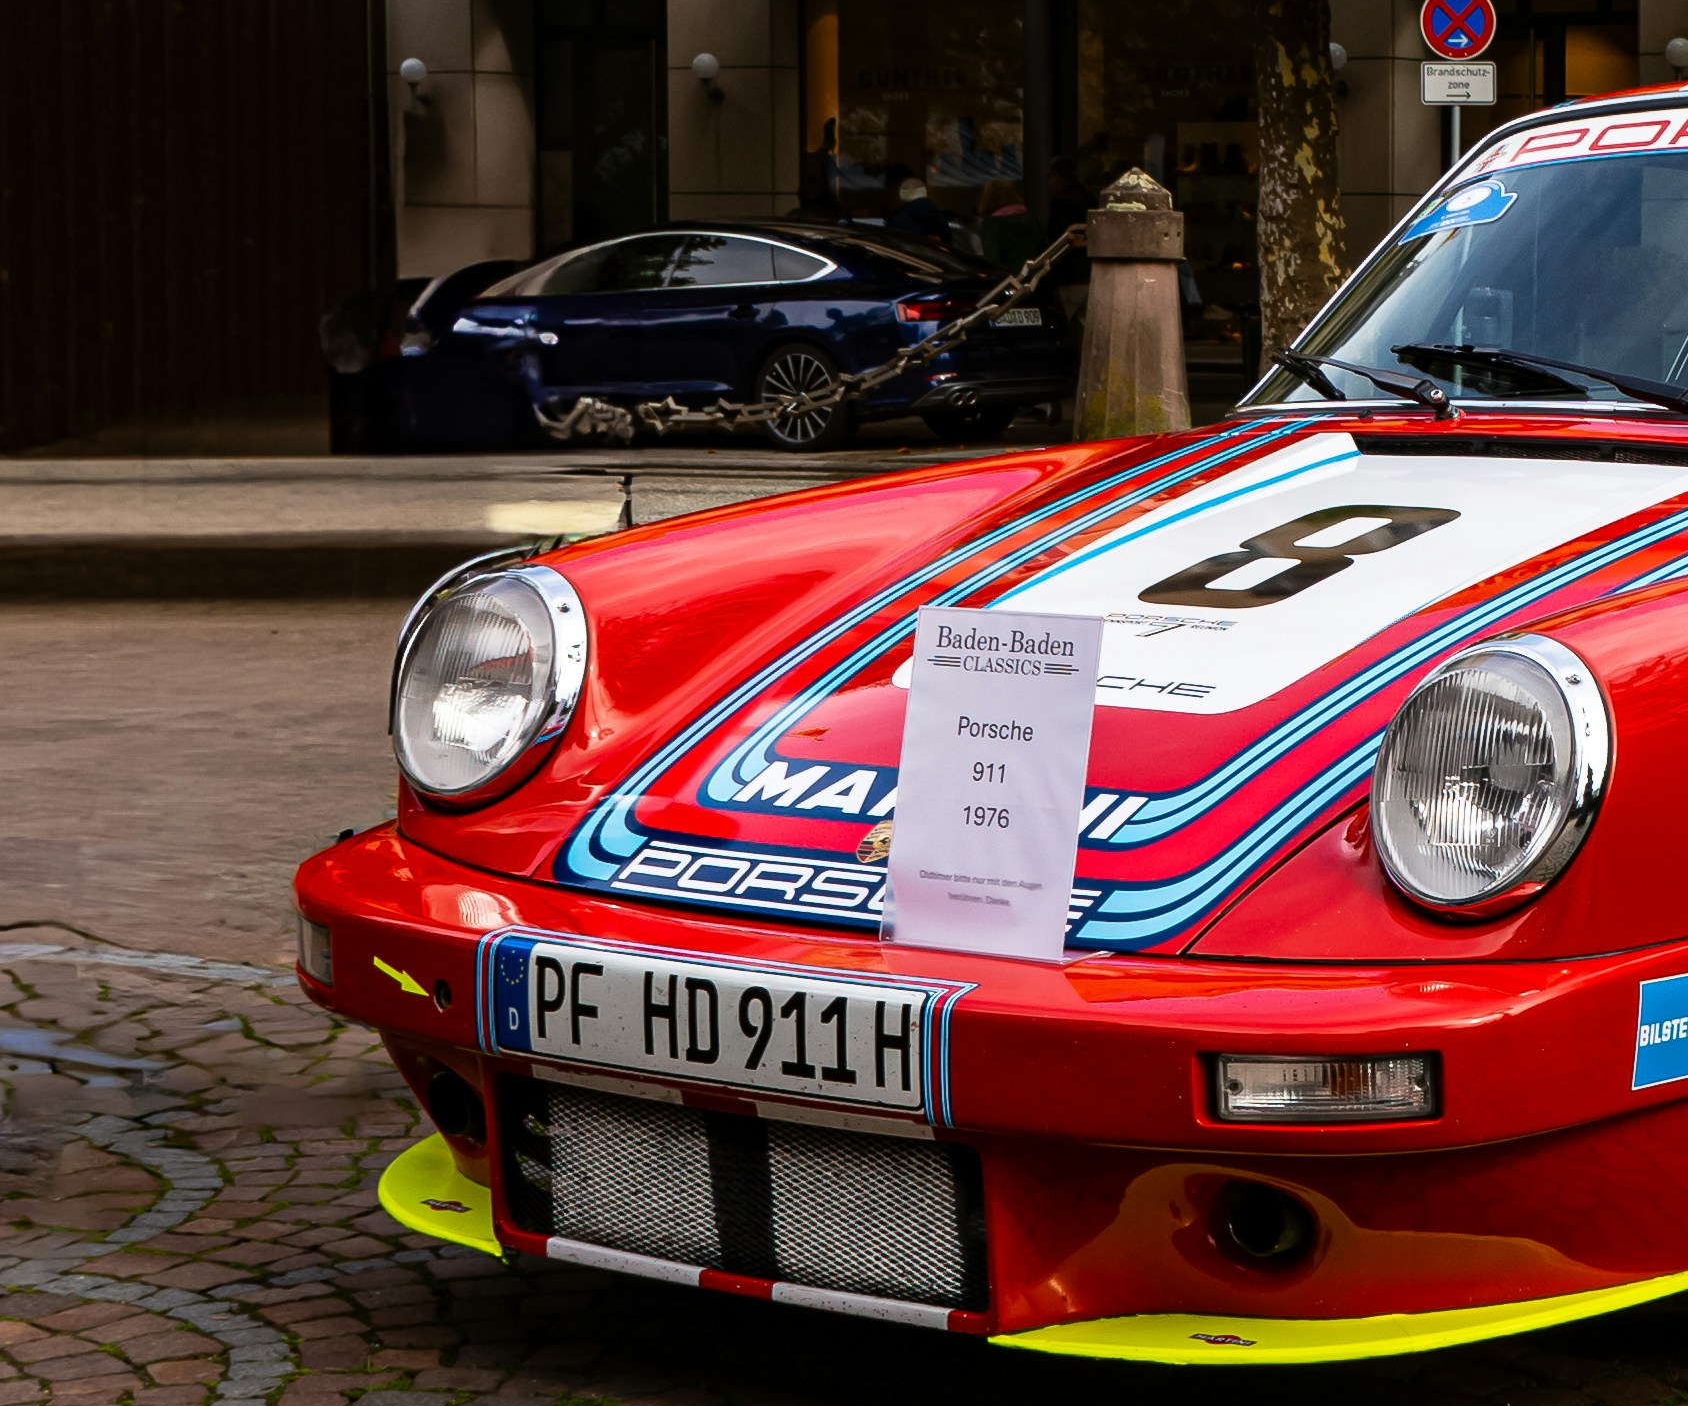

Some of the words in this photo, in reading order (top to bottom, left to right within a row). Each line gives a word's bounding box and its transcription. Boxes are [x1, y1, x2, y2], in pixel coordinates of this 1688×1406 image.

[1426, 66, 1490, 77] Brandschutz-
[1447, 81, 1470, 89] zone
[1138, 504, 1461, 609] 8
[936, 625, 1075, 657] Baden-Baden
[963, 656, 1042, 676] CLASSICS
[957, 716, 1034, 742] Porsche
[972, 761, 1007, 785] 911
[962, 804, 1010, 829] 1976
[509, 1007, 519, 1031] D
[535, 955, 604, 1045] PF
[643, 970, 721, 1065] HD
